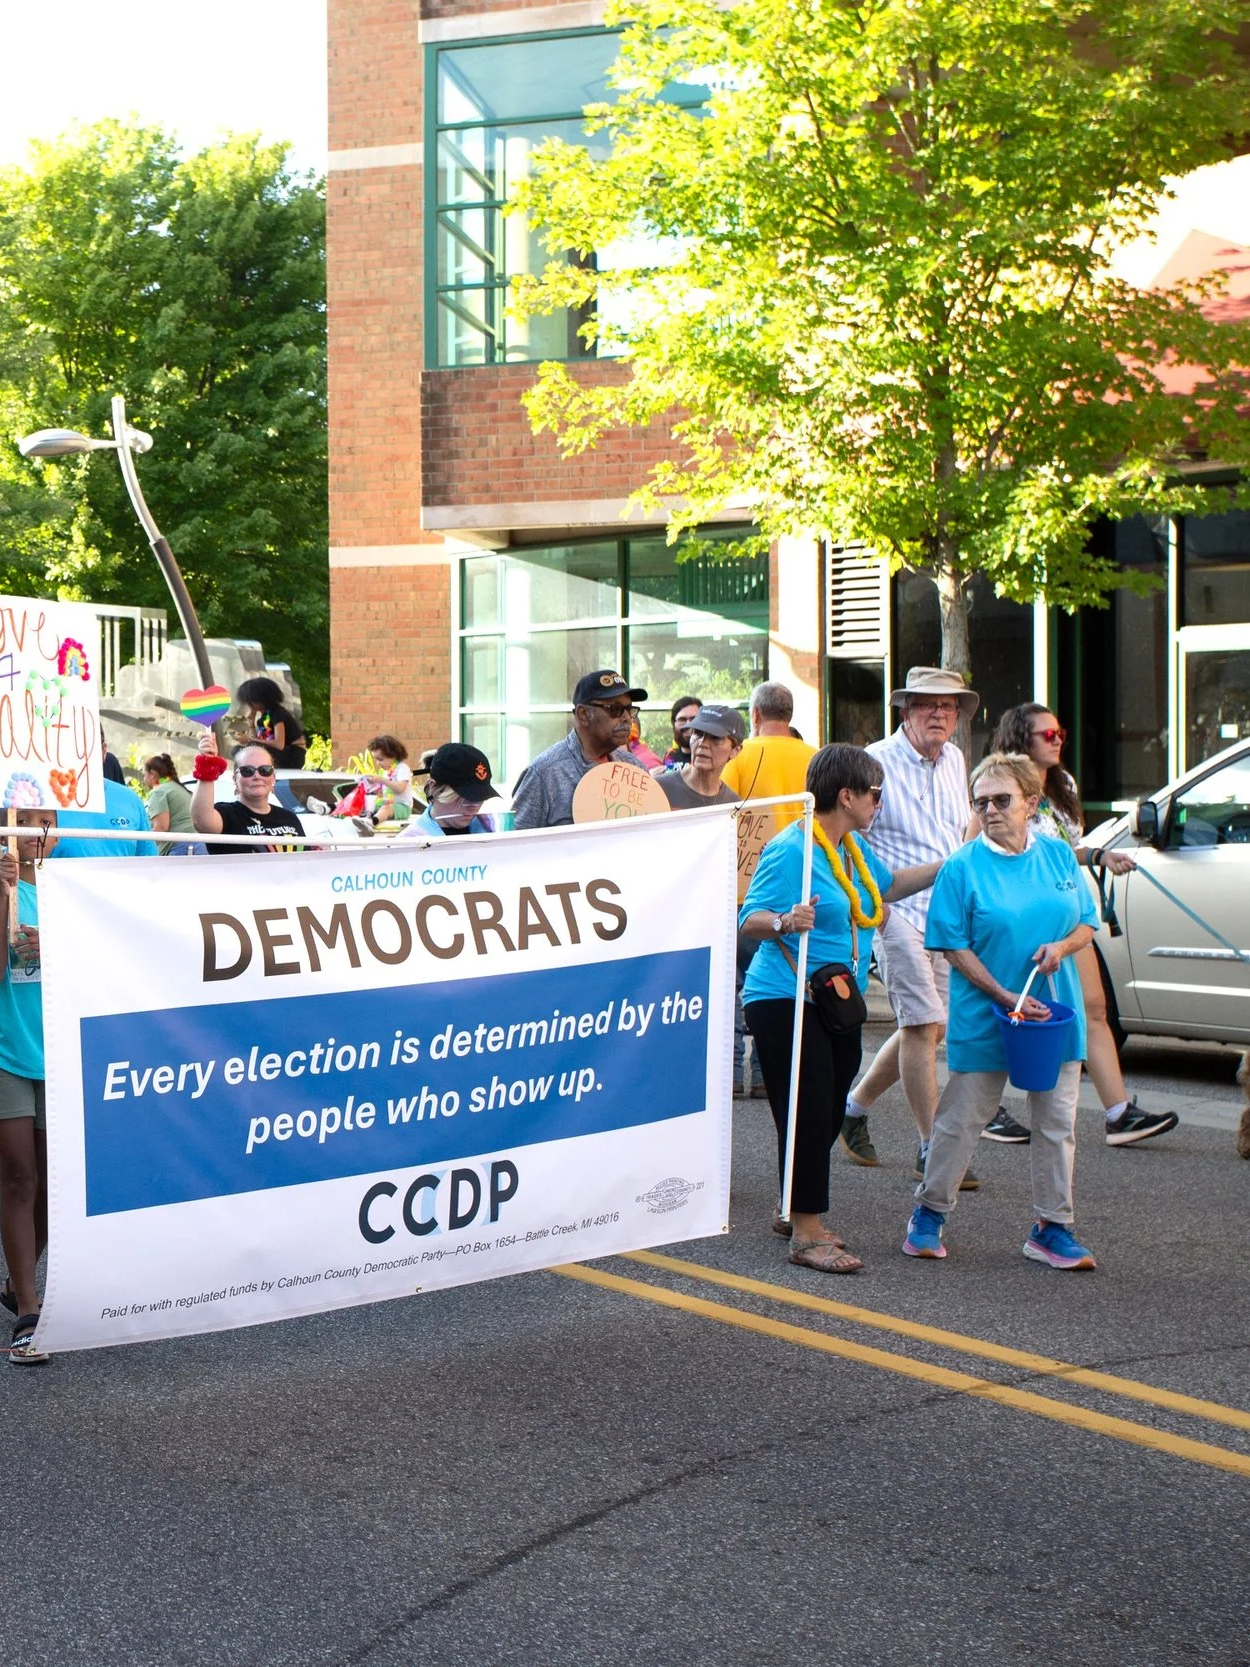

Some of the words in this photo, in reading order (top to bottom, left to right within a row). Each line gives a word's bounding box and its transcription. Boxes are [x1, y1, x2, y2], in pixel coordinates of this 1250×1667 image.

[602, 778, 620, 799] TO
[628, 789, 644, 806] BE
[611, 764, 649, 791] FREE
[604, 798, 648, 819] YO
[737, 811, 768, 840] OVE
[737, 847, 758, 876] VE
[331, 871, 414, 892] CALHOUN
[421, 865, 488, 885] COUNTY
[198, 878, 628, 982] DEMOCRATS
[103, 1060, 216, 1101] Every
[224, 1038, 381, 1085] election
[390, 1030, 420, 1065] is
[429, 1001, 614, 1060] determined
[618, 998, 655, 1037] by
[661, 991, 703, 1025] the
[246, 1095, 376, 1154] people
[387, 1086, 460, 1125] who
[468, 1076, 554, 1113] show
[558, 1067, 603, 1102] up.
[358, 1159, 519, 1245] CCDP
[101, 1305, 128, 1319] Paid
[131, 1303, 147, 1314] for
[149, 1298, 172, 1311] with
[175, 1288, 226, 1308] regulated
[230, 1282, 257, 1297] funds
[261, 1280, 274, 1292] by
[277, 1273, 321, 1288] Calhoun
[324, 1266, 361, 1278] County
[364, 1254, 419, 1274] Democratic
[473, 1241, 492, 1253] Box
[581, 1217, 592, 1229] MI
[594, 1211, 619, 1227] 49016
